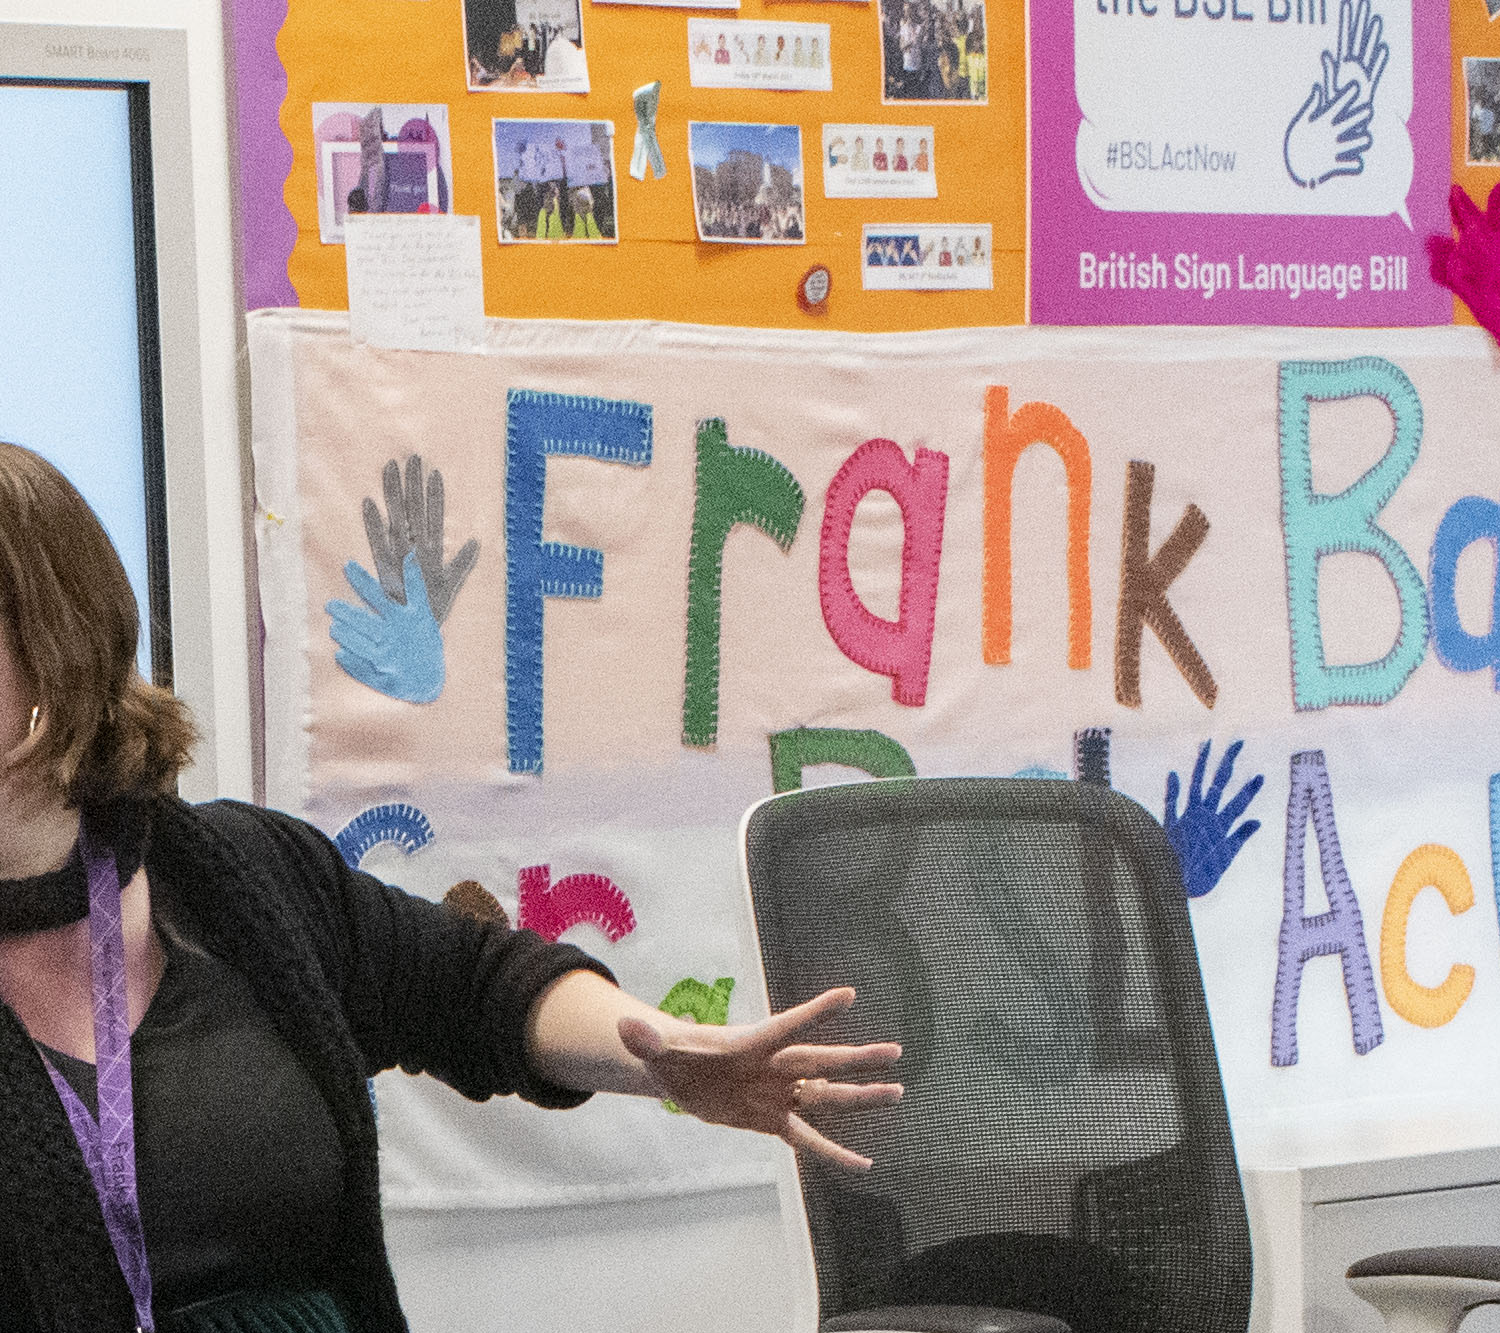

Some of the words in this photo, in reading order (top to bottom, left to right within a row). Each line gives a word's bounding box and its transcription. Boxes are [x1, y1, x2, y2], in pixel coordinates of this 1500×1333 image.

[1106, 140, 1237, 172] #BSLActNow
[1079, 251, 1168, 290] British
[1174, 252, 1232, 299] Sign
[1238, 254, 1364, 300] Language
[1369, 255, 1409, 291] Bill
[504, 383, 1218, 776] Frank
